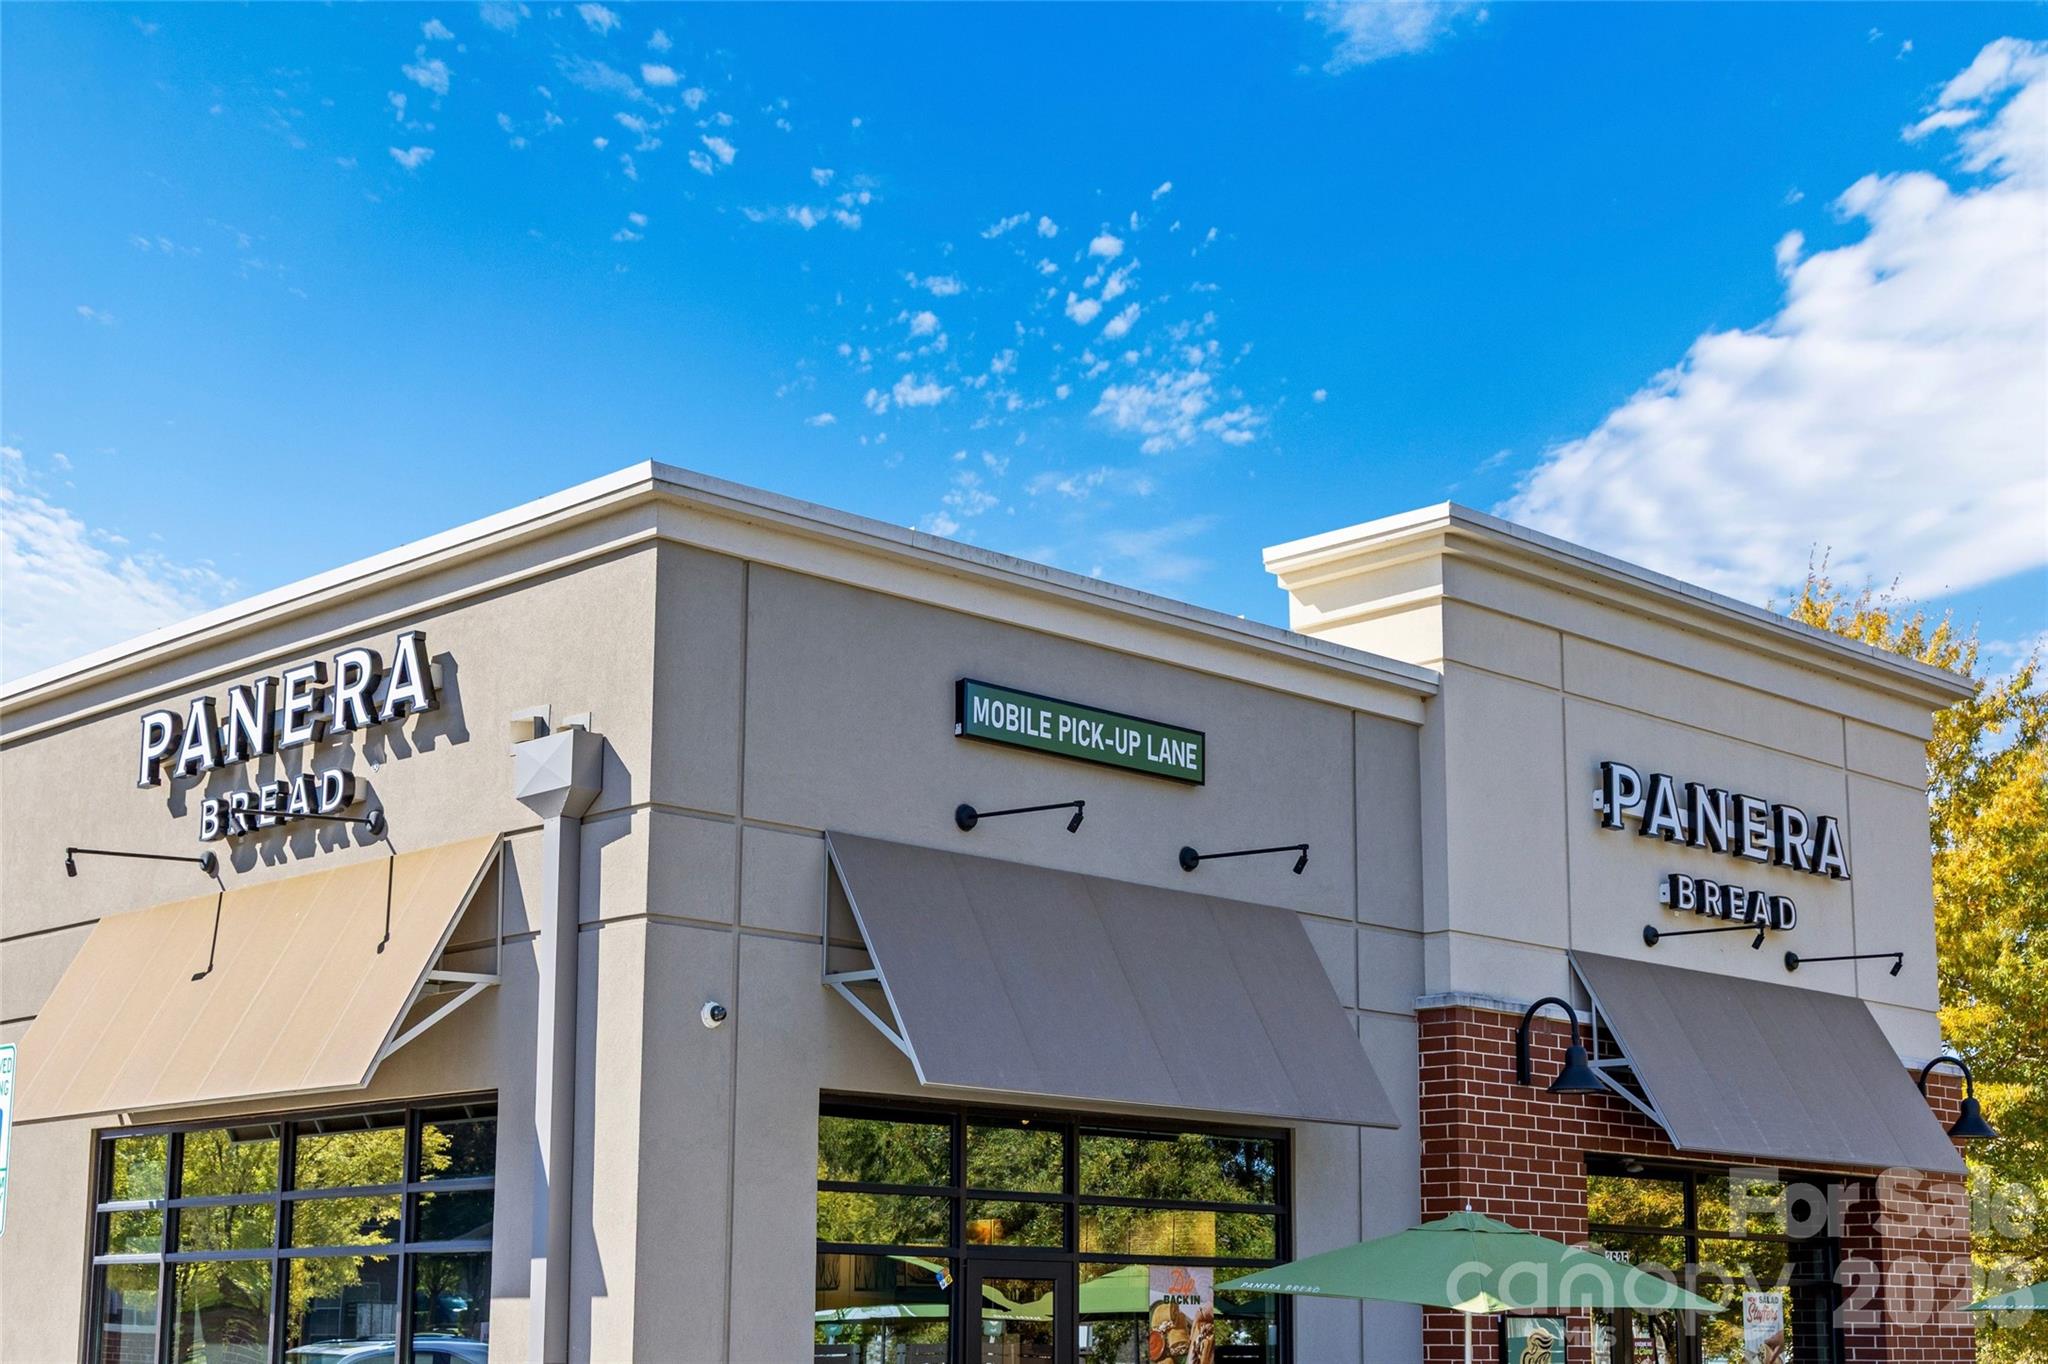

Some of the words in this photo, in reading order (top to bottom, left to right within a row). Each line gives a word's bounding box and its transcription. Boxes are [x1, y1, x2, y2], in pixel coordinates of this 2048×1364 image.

[137, 630, 440, 789] PANERA
[972, 696, 1052, 739] MOBILE
[1058, 714, 1141, 756] PICK-UP
[1147, 735, 1197, 770] LANE
[200, 768, 356, 842] BREAD
[1601, 761, 1850, 881] PANERA
[1668, 873, 1797, 931] BREAD
[1163, 1295, 1189, 1305] BACK
[1190, 1295, 1201, 1305] IN
[1240, 1281, 1281, 1290] PANERA
